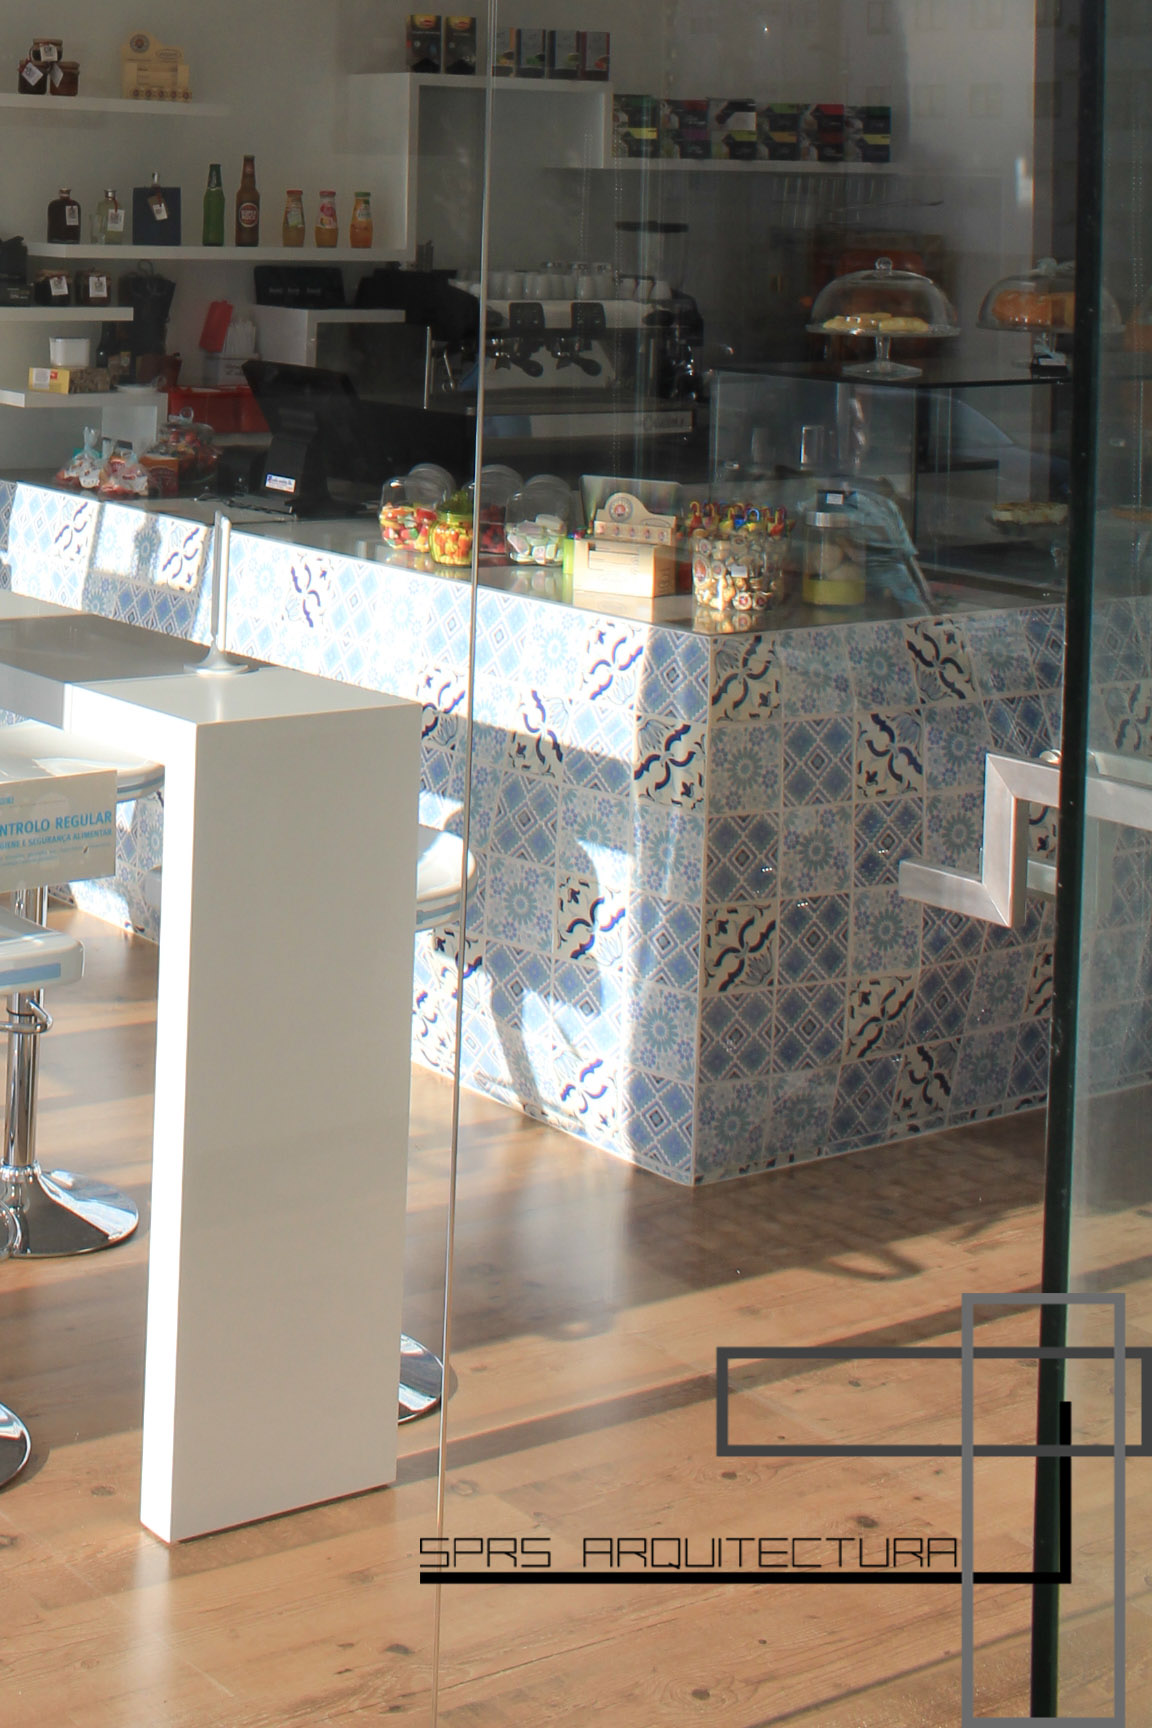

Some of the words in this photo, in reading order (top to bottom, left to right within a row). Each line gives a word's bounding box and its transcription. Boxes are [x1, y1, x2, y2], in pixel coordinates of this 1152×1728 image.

[55, 810, 112, 829] REGULAR
[28, 833, 72, 847] SEGURANÇA
[73, 827, 113, 841] ALIMENTAR
